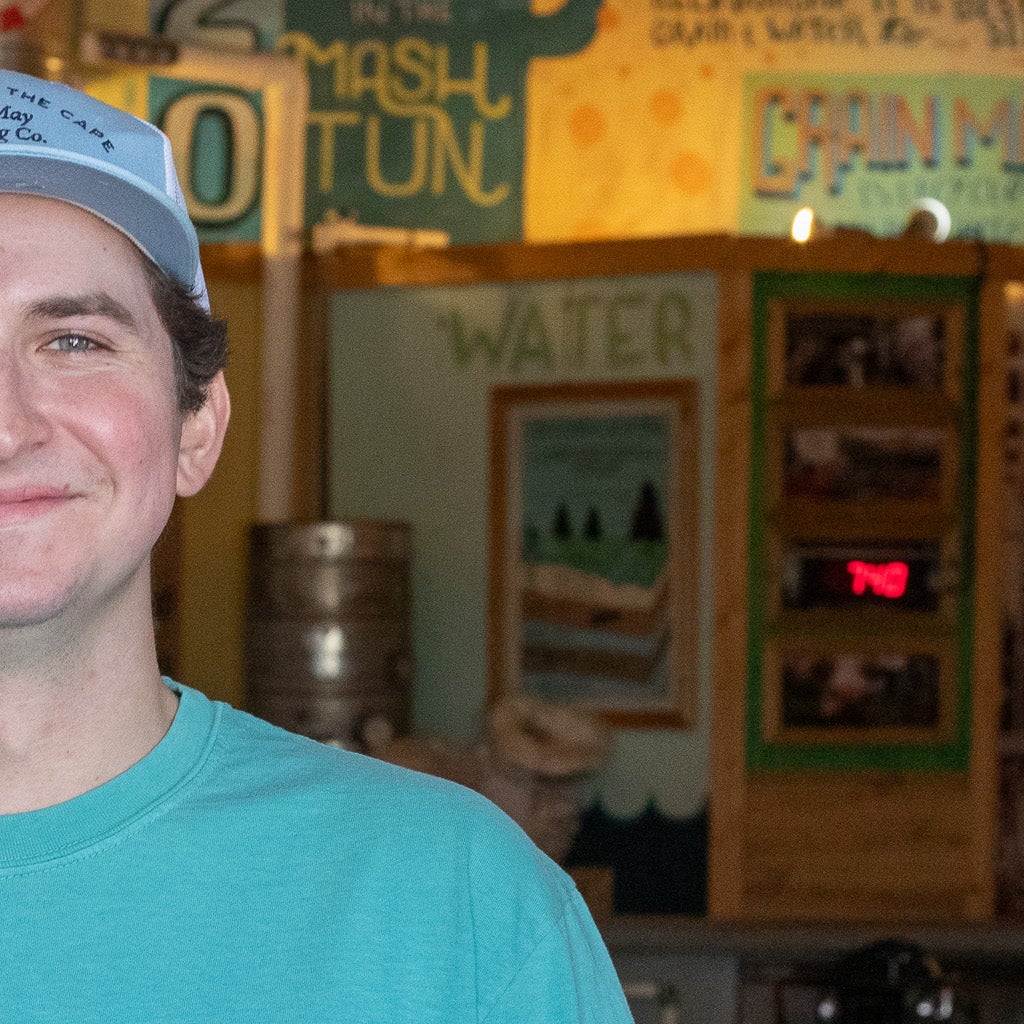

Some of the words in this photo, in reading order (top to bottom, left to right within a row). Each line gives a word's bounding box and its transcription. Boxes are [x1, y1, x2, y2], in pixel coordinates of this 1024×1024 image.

[6, 86, 51, 108] THE
[60, 109, 115, 153] CAPE
[15, 127, 47, 144] Co.
[307, 110, 510, 207] TUN
[439, 290, 695, 373] WATER
